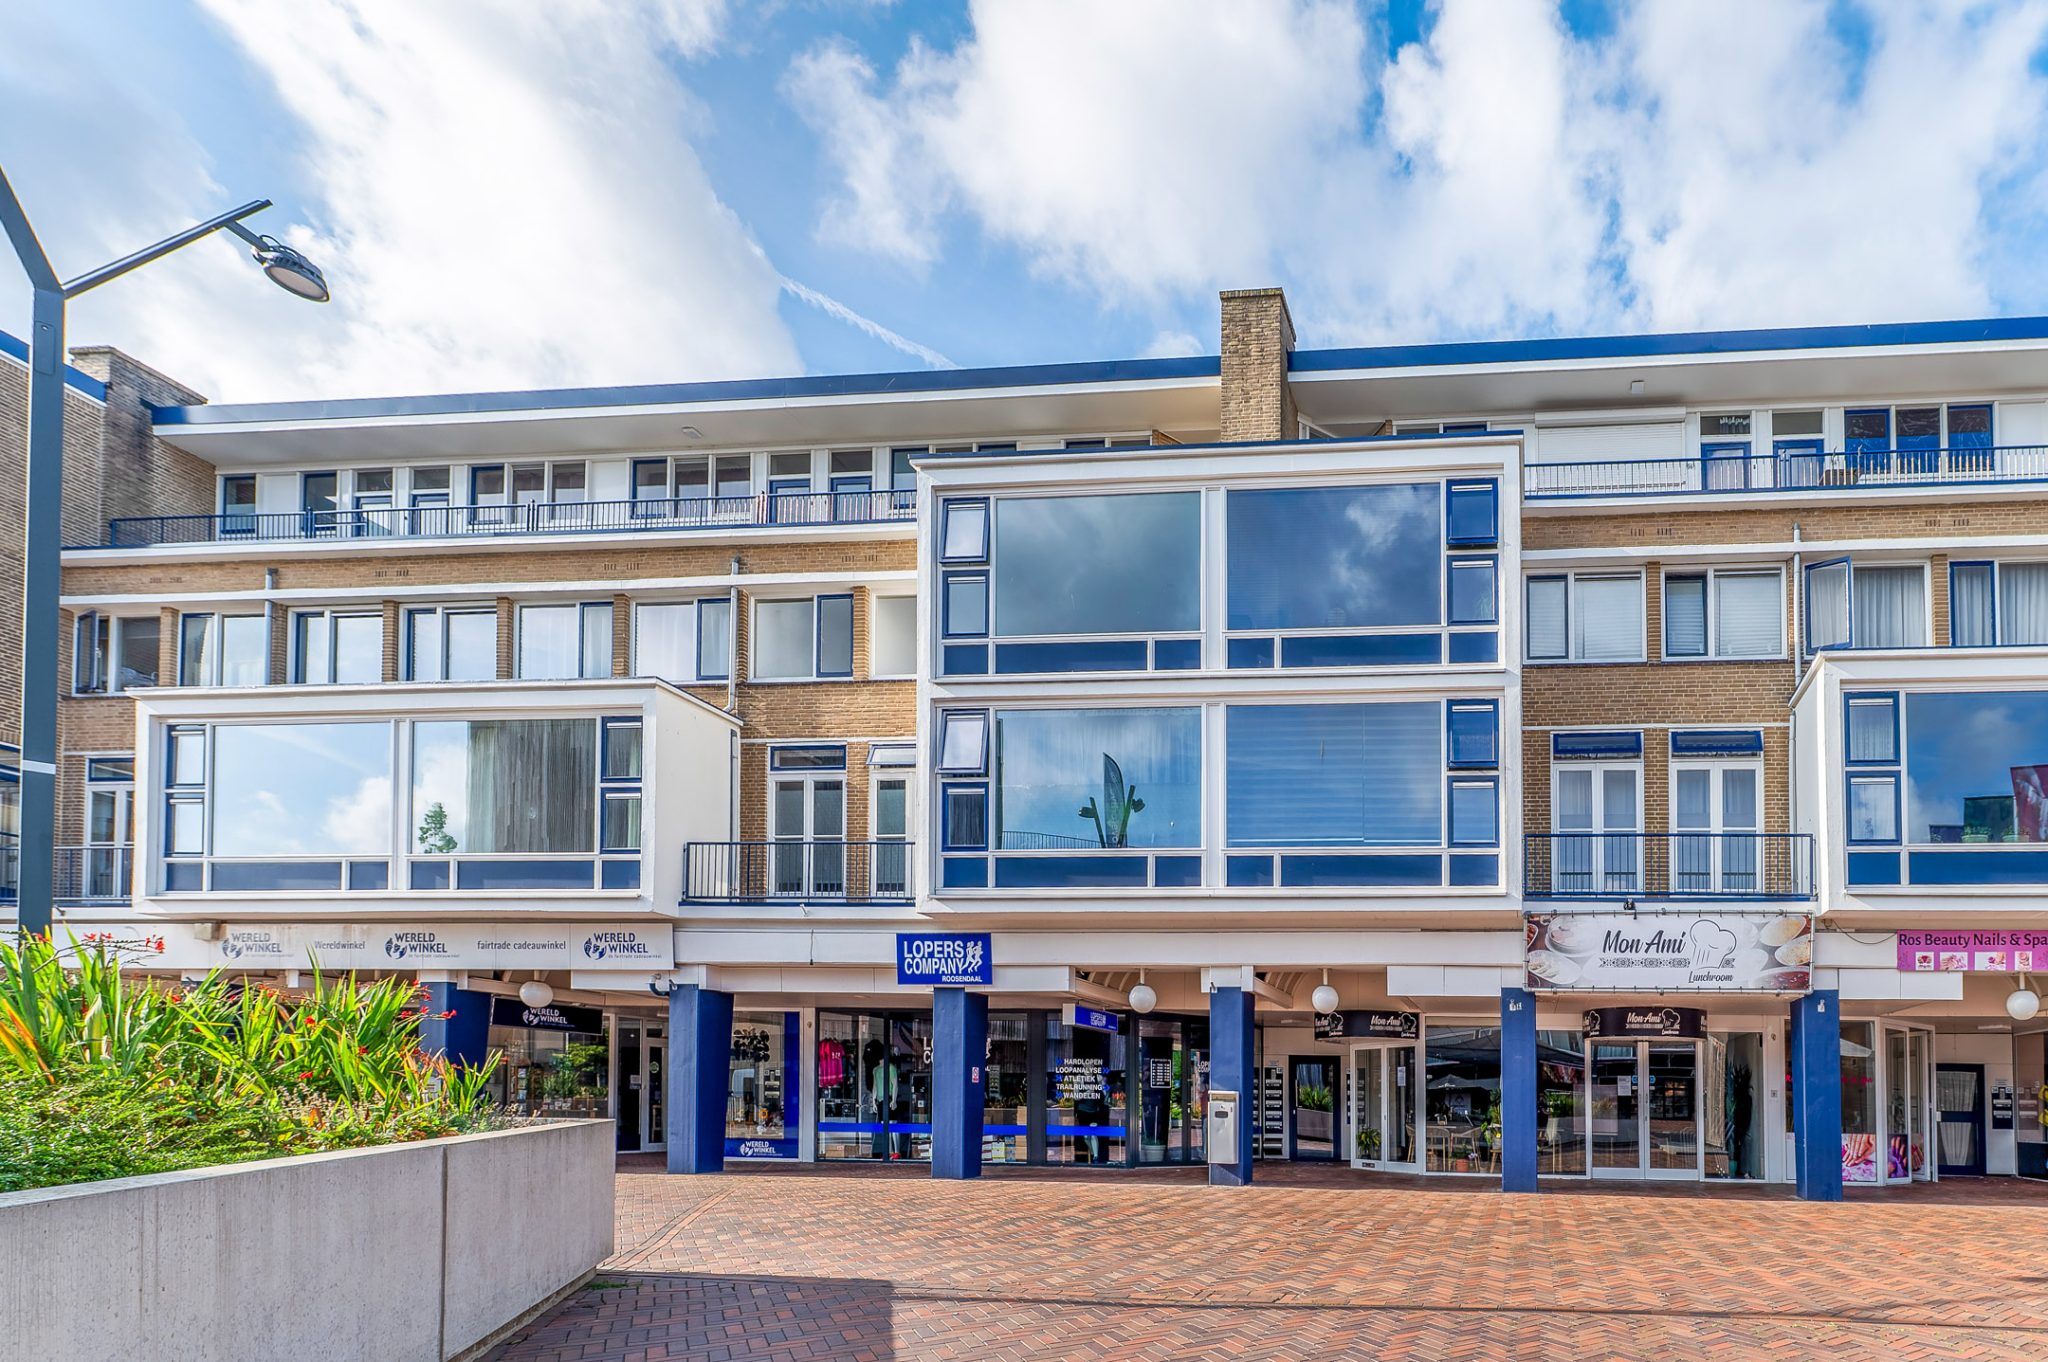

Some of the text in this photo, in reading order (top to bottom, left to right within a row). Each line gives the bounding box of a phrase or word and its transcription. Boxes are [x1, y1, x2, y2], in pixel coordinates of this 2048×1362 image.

[231, 933, 271, 942] WERELD
[394, 932, 436, 943] WERELD
[593, 932, 636, 943] WERELD
[1603, 930, 1686, 954] Mon Ami
[1899, 932, 2048, 949] Ros Beauty Nails & Spa
[244, 943, 283, 953] WINKEL
[314, 940, 366, 950] Wereldwinkel
[408, 943, 448, 953] WINKEL
[477, 940, 566, 950] fairtrade cadeauwinkel
[608, 943, 649, 954] WINKEL
[904, 941, 964, 958] LOPERS
[904, 957, 965, 975] COMPANY
[941, 975, 983, 983] ROOSENDAAL
[1688, 970, 1734, 984] Lunchroom
[530, 1007, 560, 1017] WERELD
[540, 1014, 568, 1025] WINKEL
[1370, 1015, 1401, 1026] Mon Ami
[1626, 1012, 1662, 1023] Mon Ami
[1063, 1058, 1103, 1066] HARDLOPEN
[1063, 1074, 1096, 1083] ATLETIEK
[1056, 1083, 1103, 1091] TRAILRUNNING
[1063, 1092, 1101, 1100] WANDELEN
